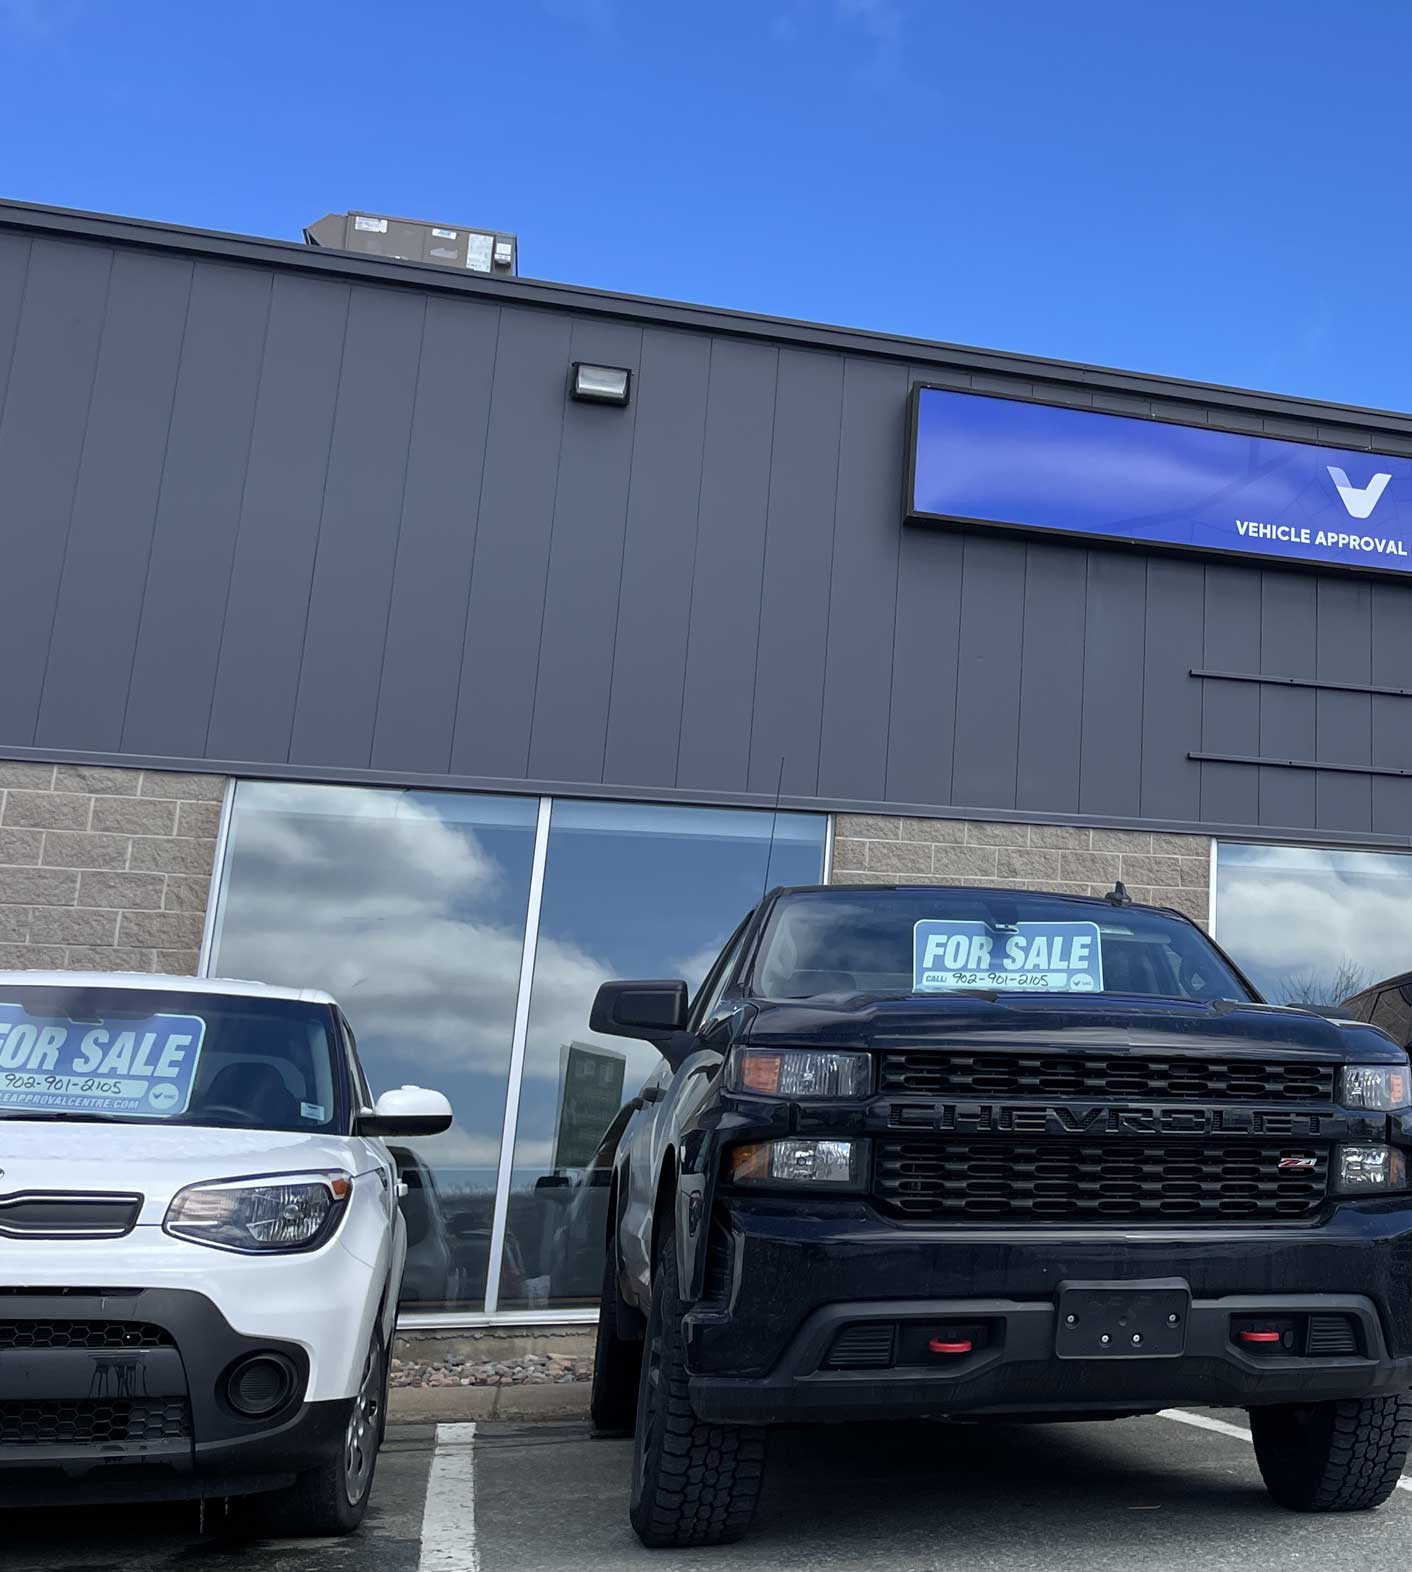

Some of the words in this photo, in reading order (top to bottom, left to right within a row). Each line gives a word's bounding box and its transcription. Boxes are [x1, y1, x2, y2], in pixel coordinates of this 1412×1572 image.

[1235, 519, 1311, 544] VEHICLE
[1315, 530, 1408, 556] APPROVAL
[922, 934, 994, 970] FOR
[1002, 935, 1092, 970] SALE
[925, 975, 947, 983] CALL:
[952, 973, 1049, 987] 902-901-2105
[72, 1028, 192, 1078] SALE
[4, 1073, 122, 1094] 902-901-2105
[0, 1093, 139, 1109] EAPPROVALCENTRE.COM
[888, 1104, 1334, 1135] CHEVROLET
